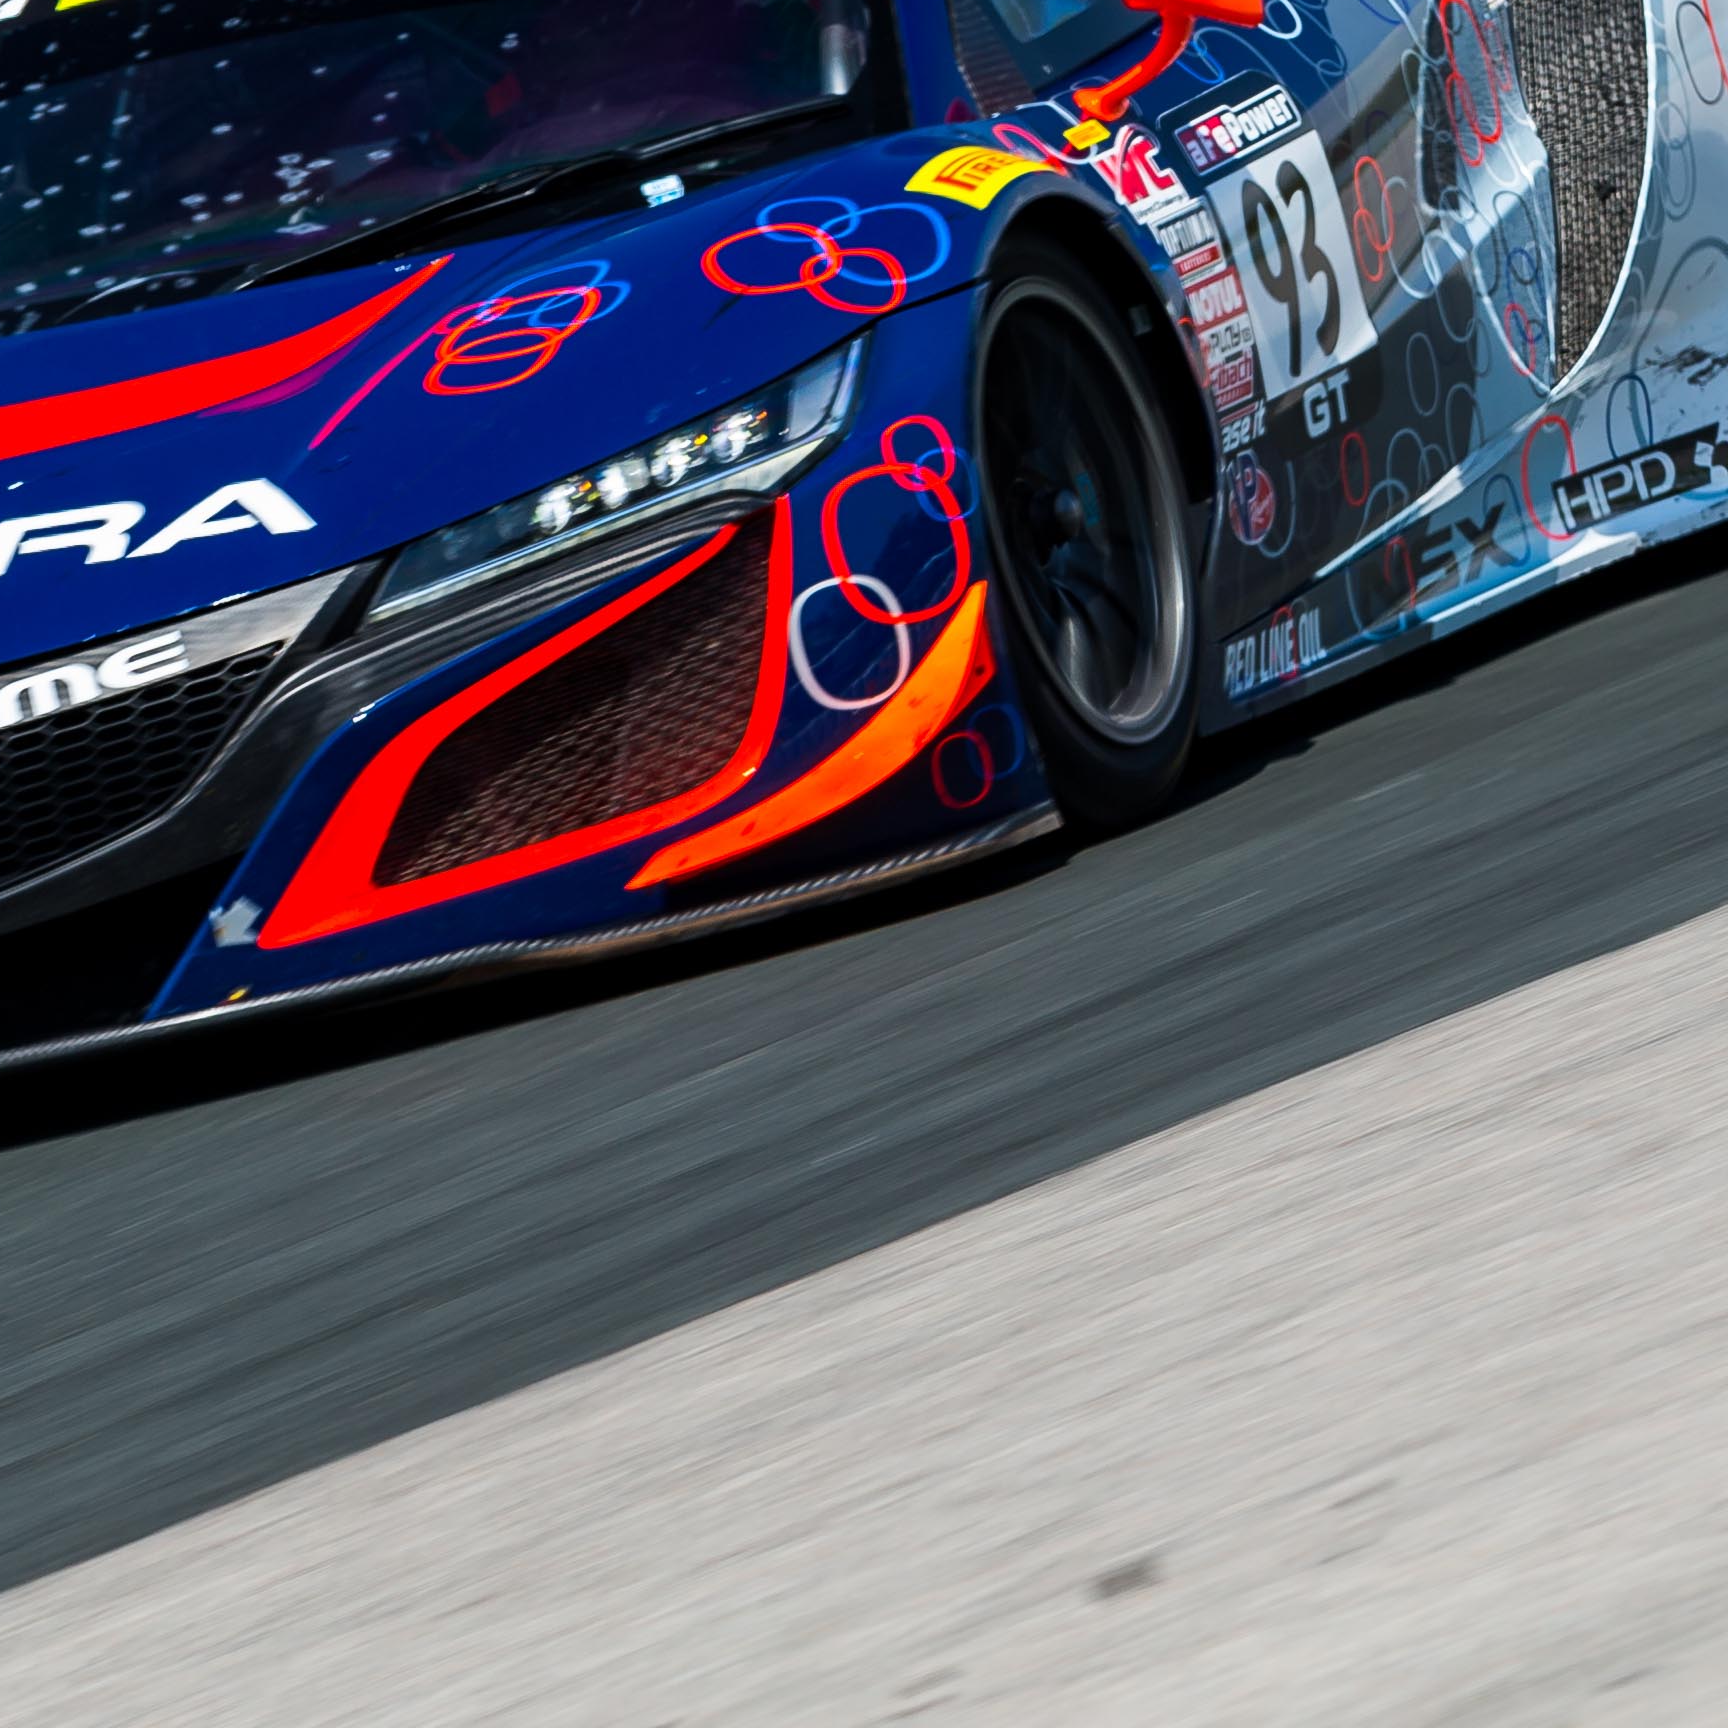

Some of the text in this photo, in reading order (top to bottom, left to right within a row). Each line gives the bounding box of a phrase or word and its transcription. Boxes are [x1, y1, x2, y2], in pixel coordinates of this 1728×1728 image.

[1241, 159, 1341, 378] 93
[1302, 373, 1350, 438] GT
[1556, 450, 1677, 528] HPD
[1225, 606, 1327, 695] RED LINE OIL
